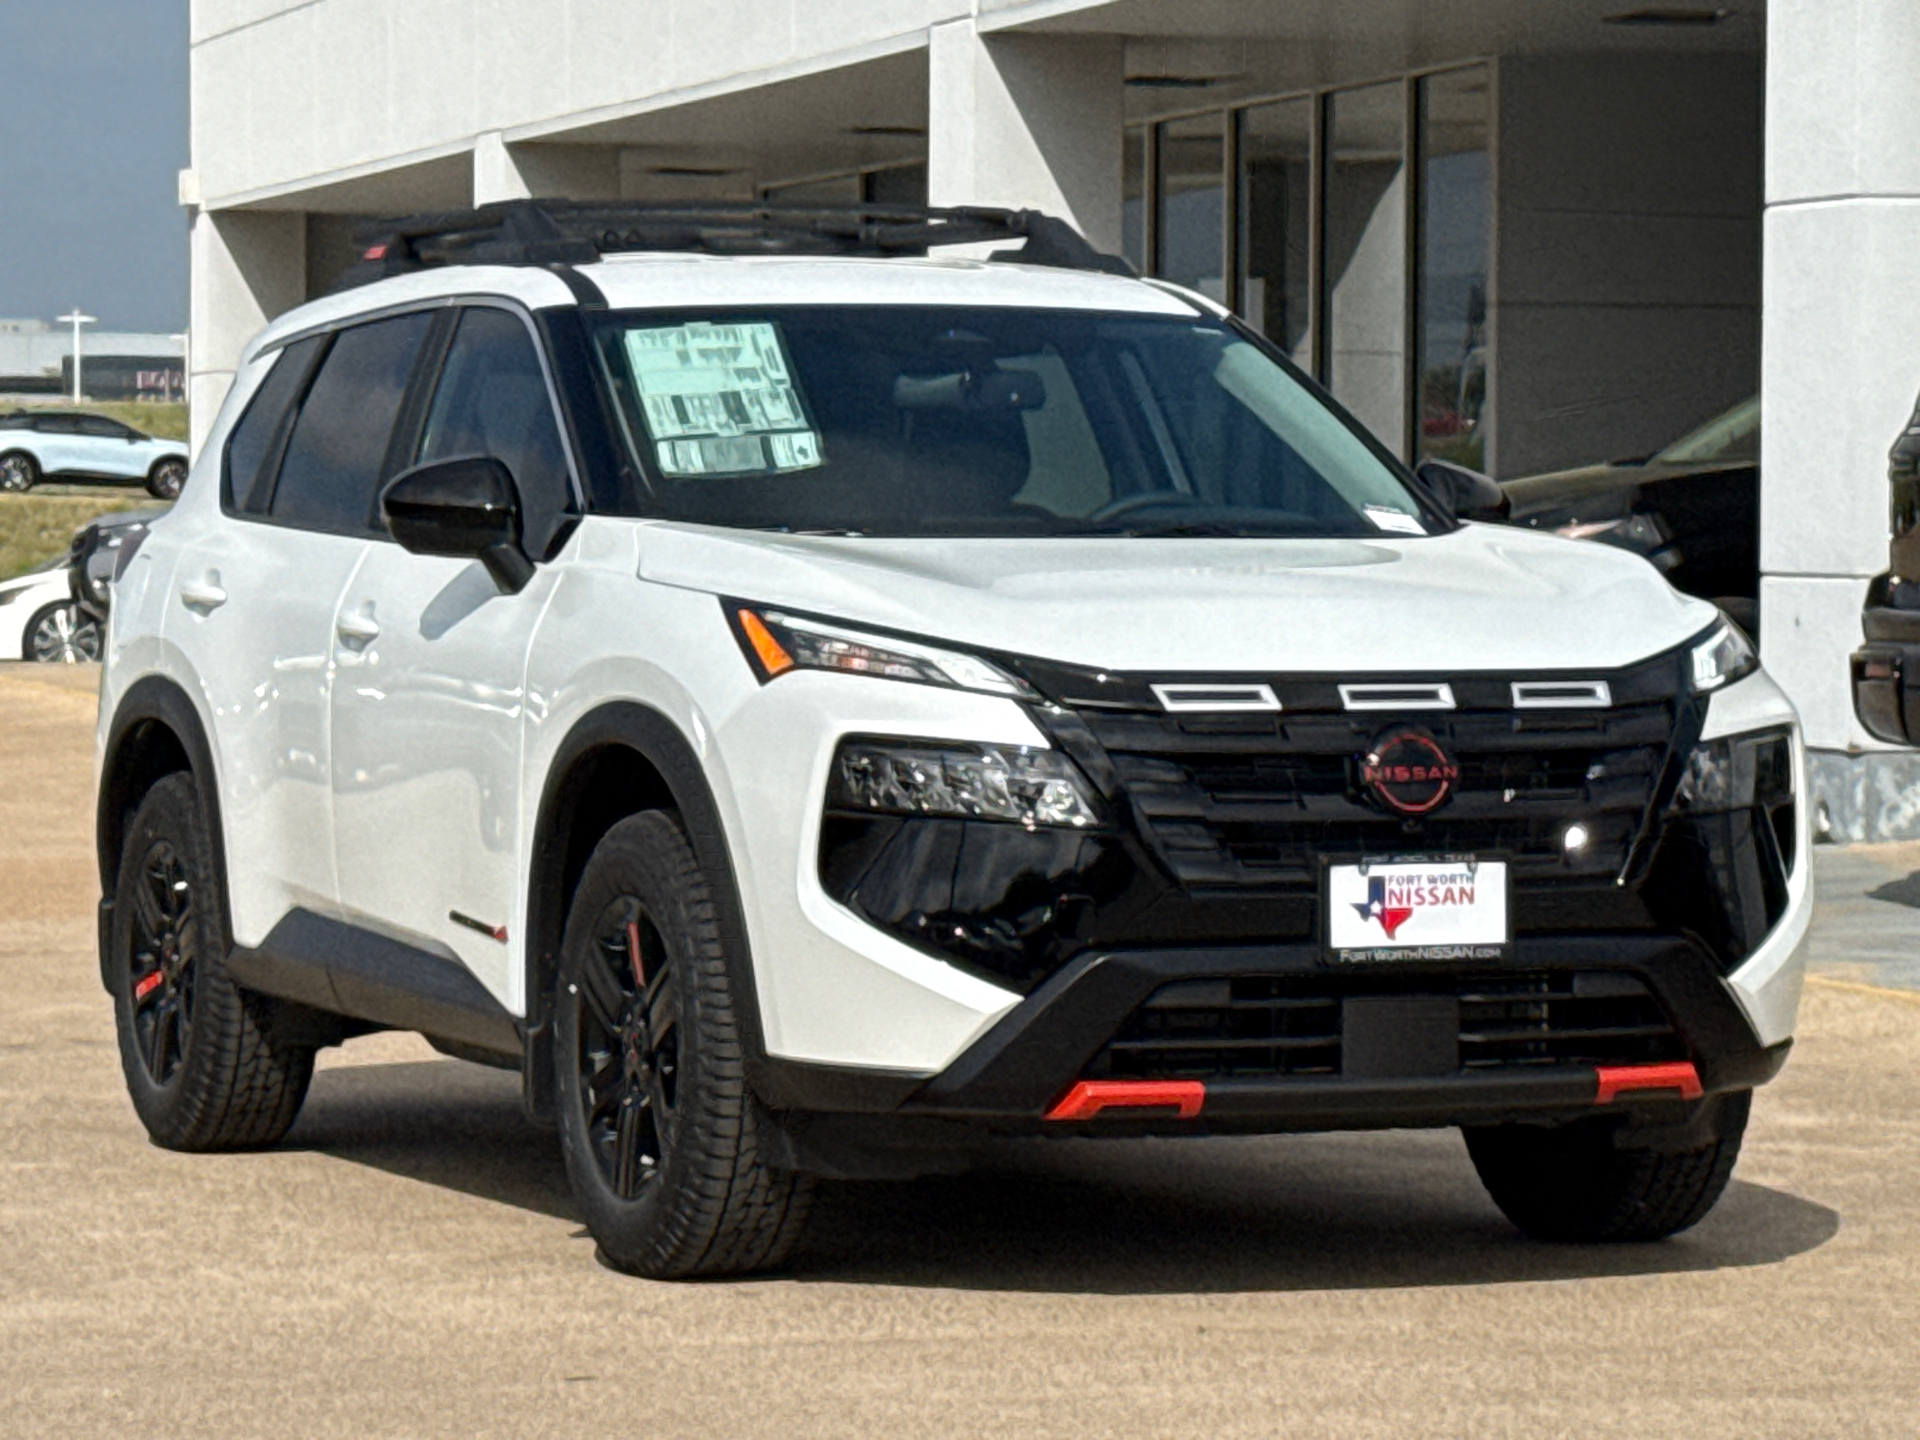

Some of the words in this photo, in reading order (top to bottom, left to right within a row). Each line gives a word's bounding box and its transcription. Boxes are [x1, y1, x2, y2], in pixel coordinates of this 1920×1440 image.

[1364, 766, 1458, 782] NISSAN
[1387, 874, 1422, 886] FORT
[1427, 873, 1476, 886] WORTH
[1387, 886, 1475, 906] NISSAN
